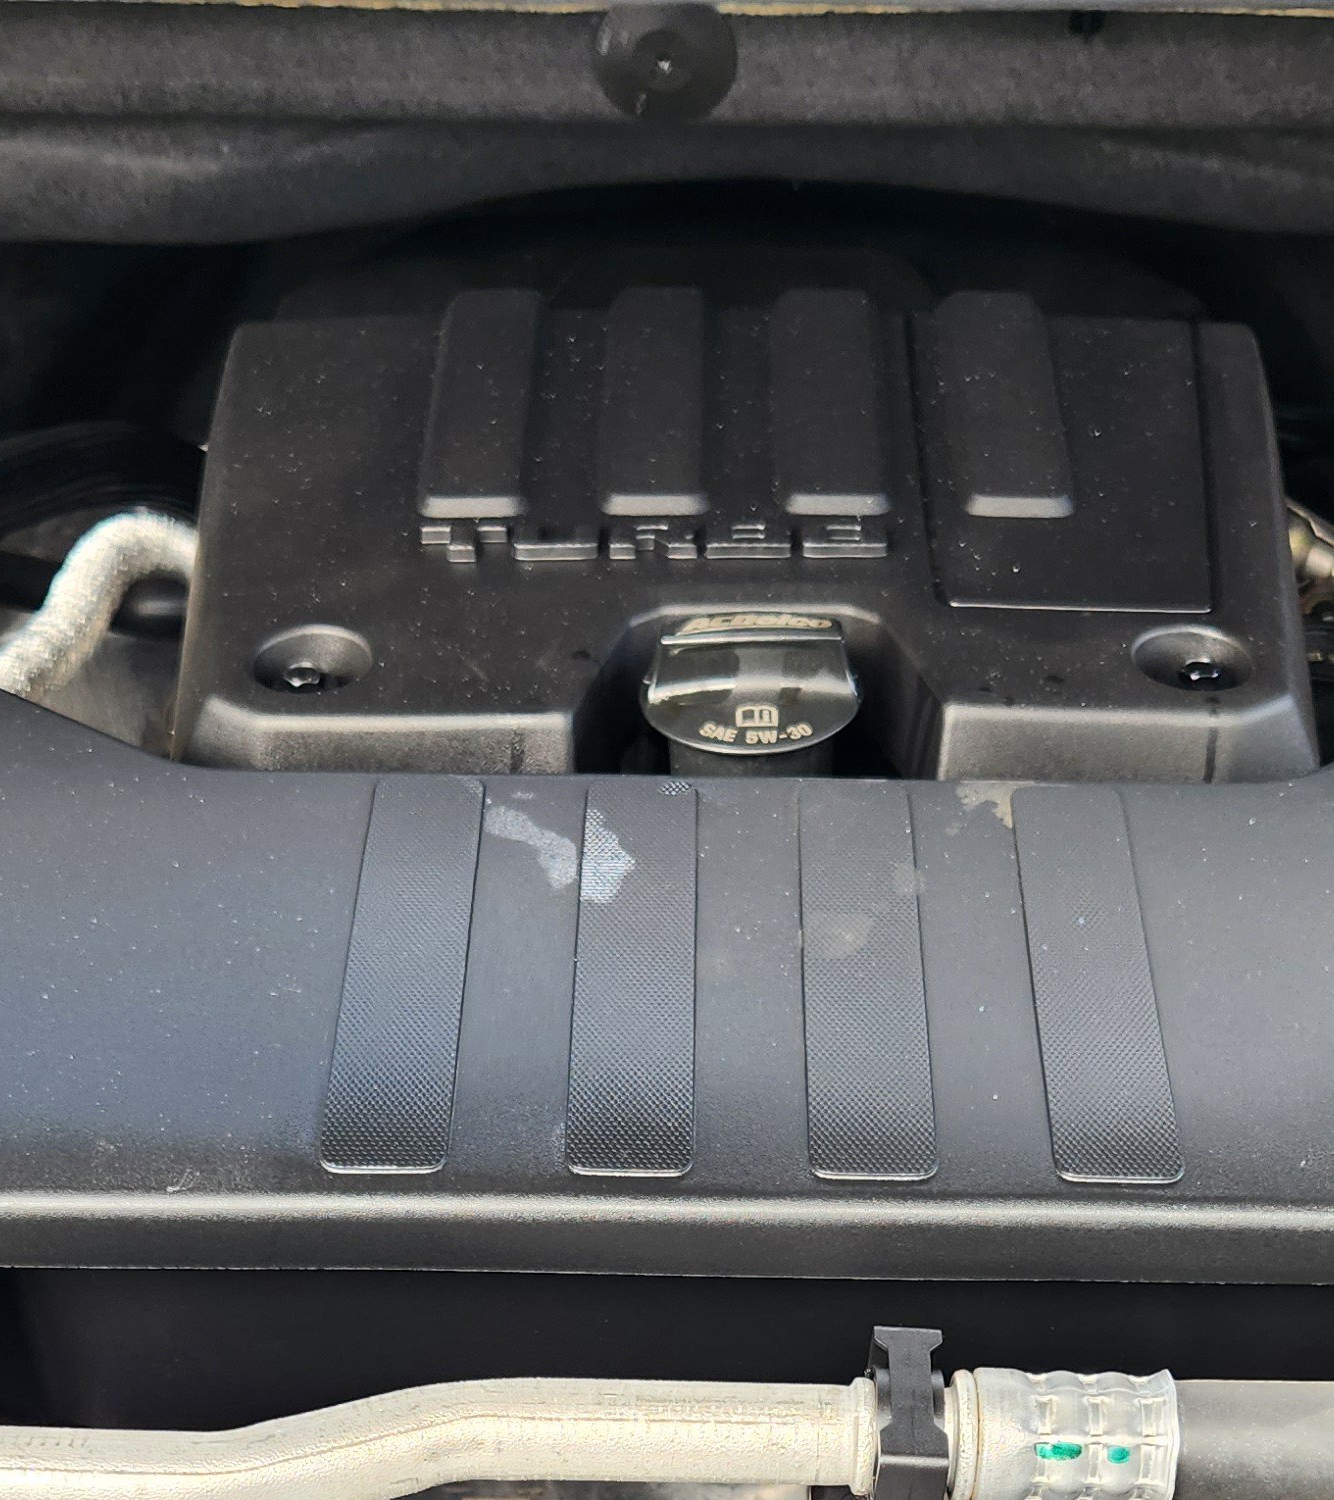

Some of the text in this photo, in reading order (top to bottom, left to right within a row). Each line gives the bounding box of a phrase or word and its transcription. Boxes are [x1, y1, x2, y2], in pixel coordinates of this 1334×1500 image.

[676, 613, 834, 636] ACDelco
[698, 722, 814, 745] SAE 5W-30
